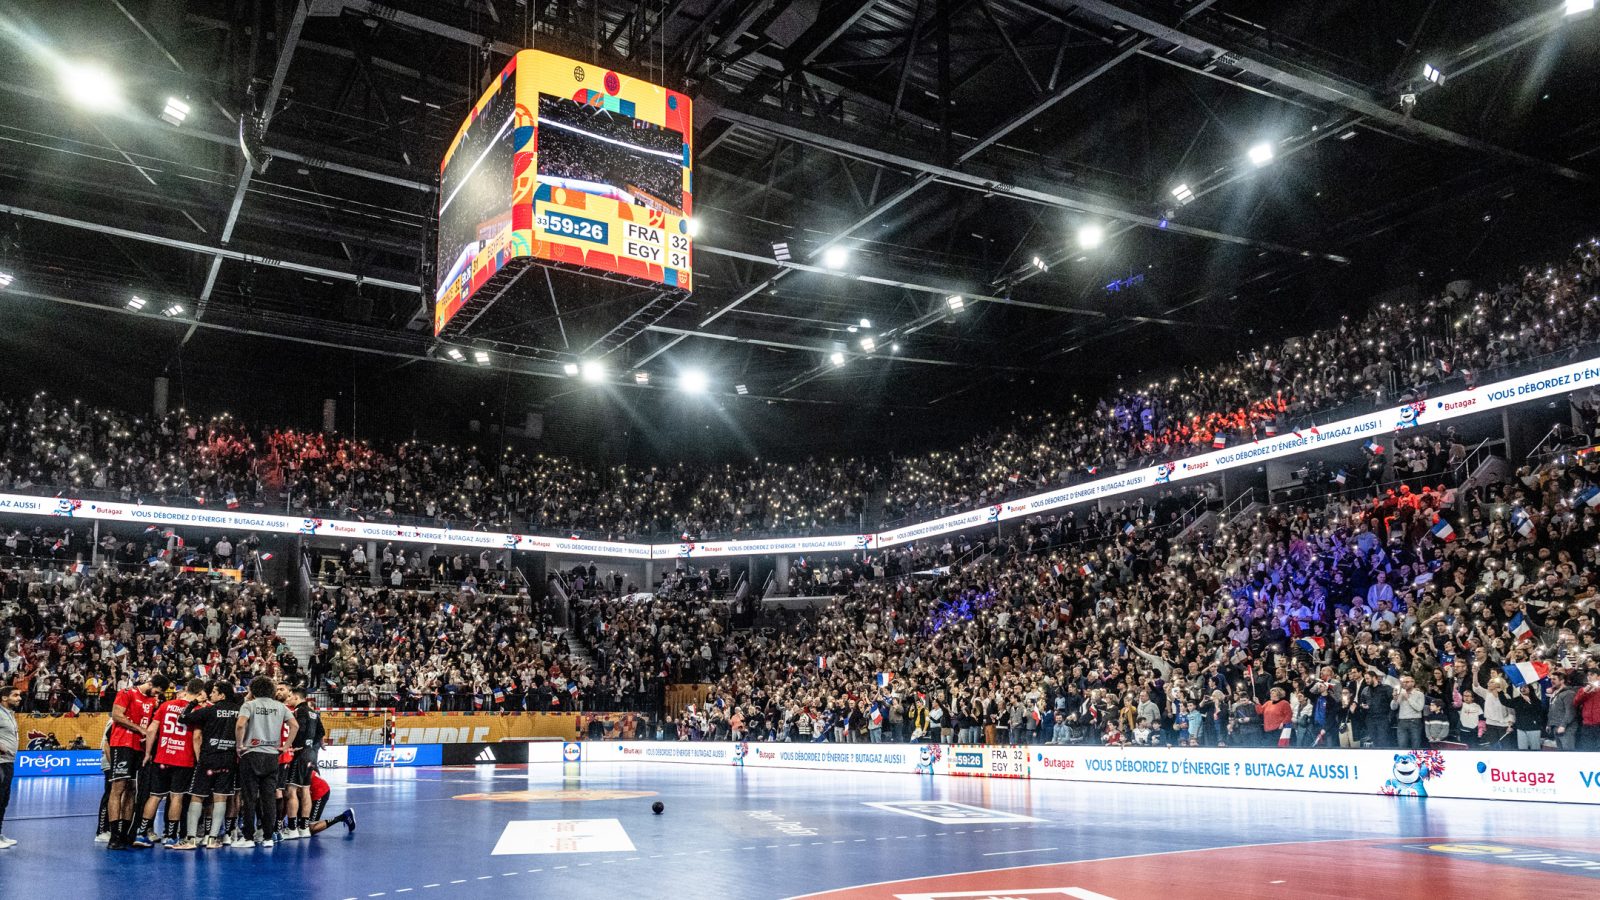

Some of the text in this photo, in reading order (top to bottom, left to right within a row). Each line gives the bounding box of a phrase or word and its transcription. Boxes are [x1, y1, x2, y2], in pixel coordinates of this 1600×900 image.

[549, 216, 603, 240] 59:26
[628, 224, 688, 251] FRA 32
[628, 242, 686, 268] EGY 31
[1488, 388, 1515, 402] VOUS
[1518, 374, 1570, 395] DÉBORDEZ
[1444, 398, 1476, 410] Butagaz
[1216, 454, 1234, 465] VOUS
[1236, 446, 1270, 460] DÉBORDEZ
[1317, 426, 1352, 442] BUTAGAZ
[1354, 421, 1377, 433] AUSSI
[1187, 461, 1208, 471] Butagaz
[1101, 481, 1125, 492] BUTAGAZ
[1127, 477, 1142, 485] AUSSI
[780, 752, 794, 760] VOUS
[856, 754, 882, 763] BUTAGAZ
[884, 754, 902, 764] AUSSI
[958, 755, 980, 766] 59:26
[992, 750, 1022, 760] FRA 32
[992, 762, 1022, 772] EGY 31
[1044, 758, 1074, 770] Butagaz
[1085, 760, 1112, 772] VOUS
[1115, 757, 1168, 774] DÉBORDEZ
[1172, 758, 1230, 776] D'ÉNERGIE
[1245, 762, 1304, 778] BUTAGAZ
[1308, 764, 1348, 779] AUSSI
[1490, 768, 1555, 786] Butagaz
